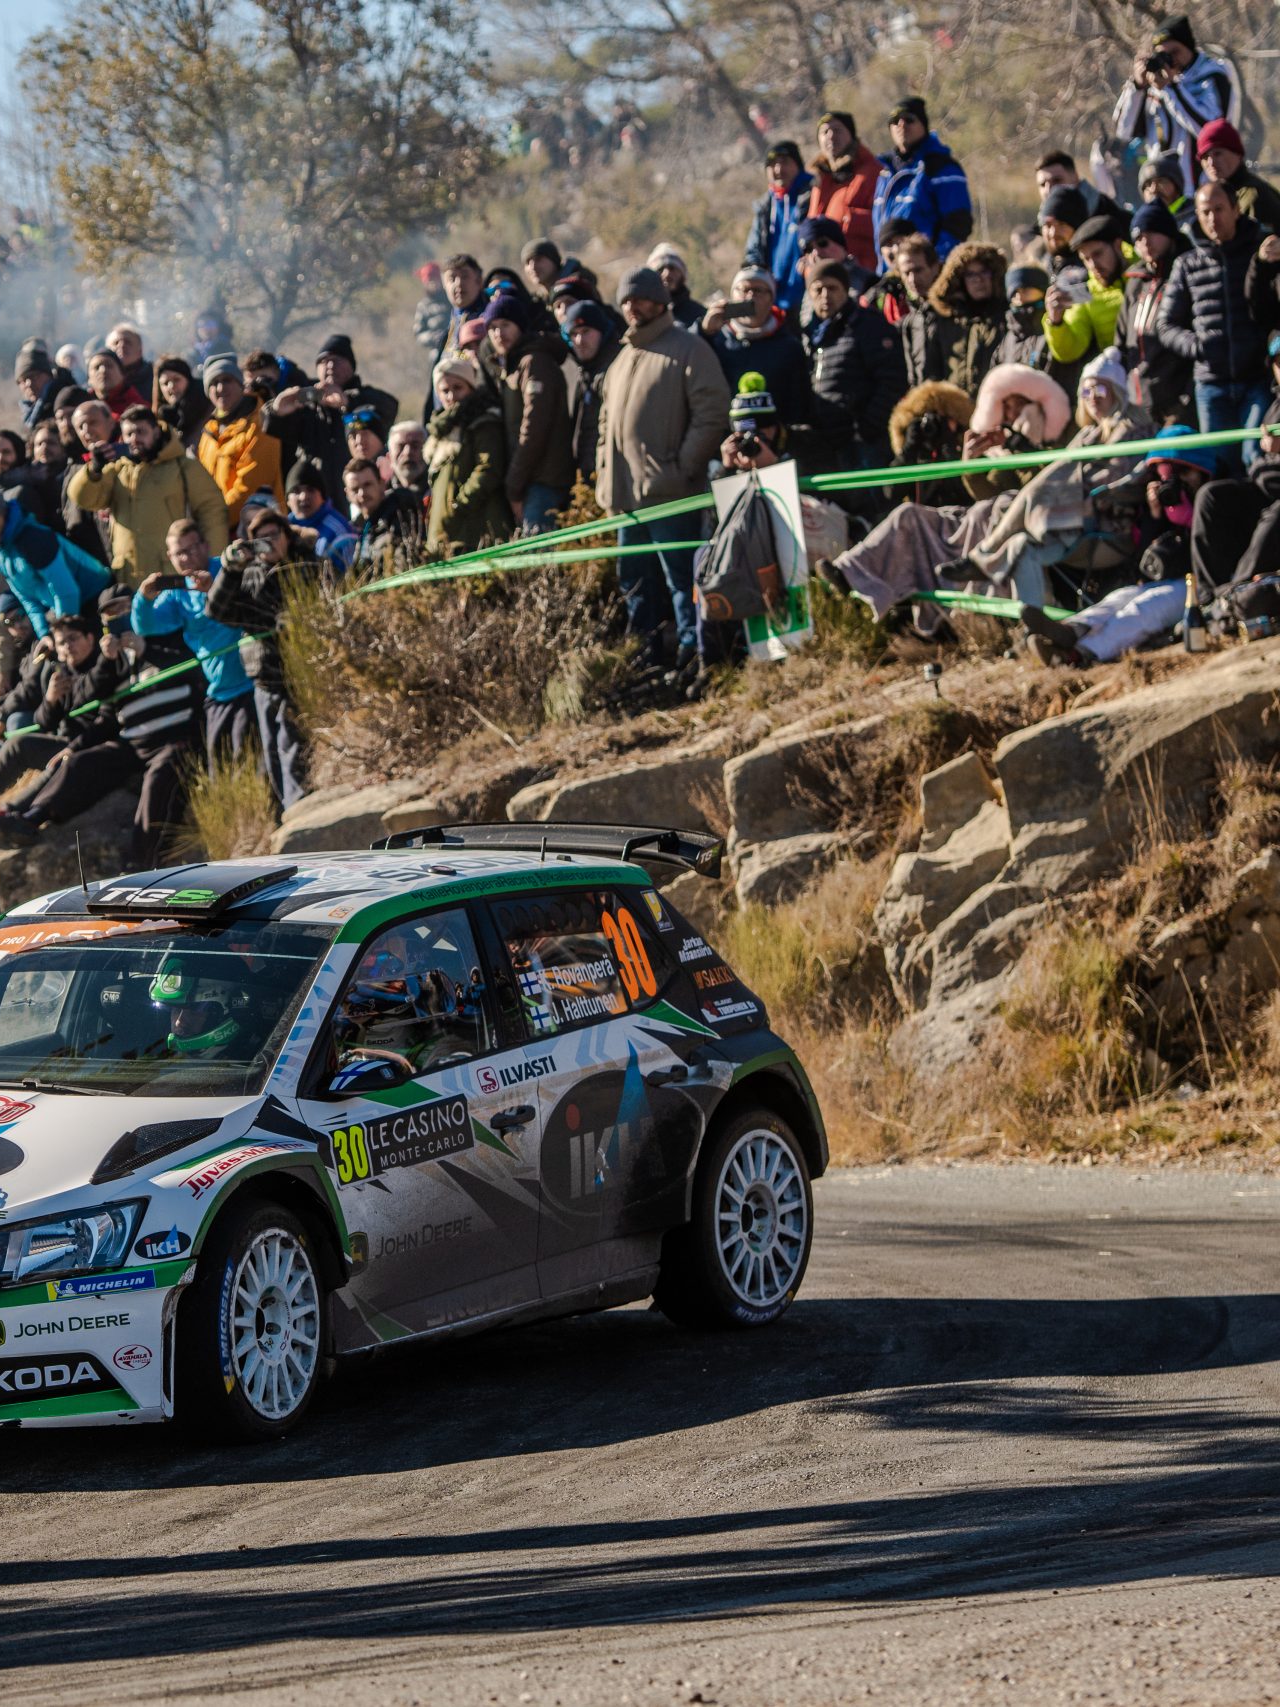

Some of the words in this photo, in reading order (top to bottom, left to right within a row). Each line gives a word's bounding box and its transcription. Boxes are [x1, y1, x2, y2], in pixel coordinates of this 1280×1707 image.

[99, 887, 218, 904] TGS
[3, 935, 25, 946] PRO
[601, 907, 657, 1000] 30
[552, 954, 615, 989] Rovanperä
[552, 1001, 564, 1025] J.
[561, 992, 619, 1022] Halttunen
[369, 1122, 389, 1150] LE
[392, 1101, 466, 1143] CASINO
[333, 1125, 370, 1183] 30
[376, 1231, 418, 1259] JOHN
[422, 1216, 473, 1245] DEERE
[78, 1276, 146, 1293] MICHELIN
[13, 1320, 64, 1338] JOHN
[69, 1313, 131, 1332] DEERE
